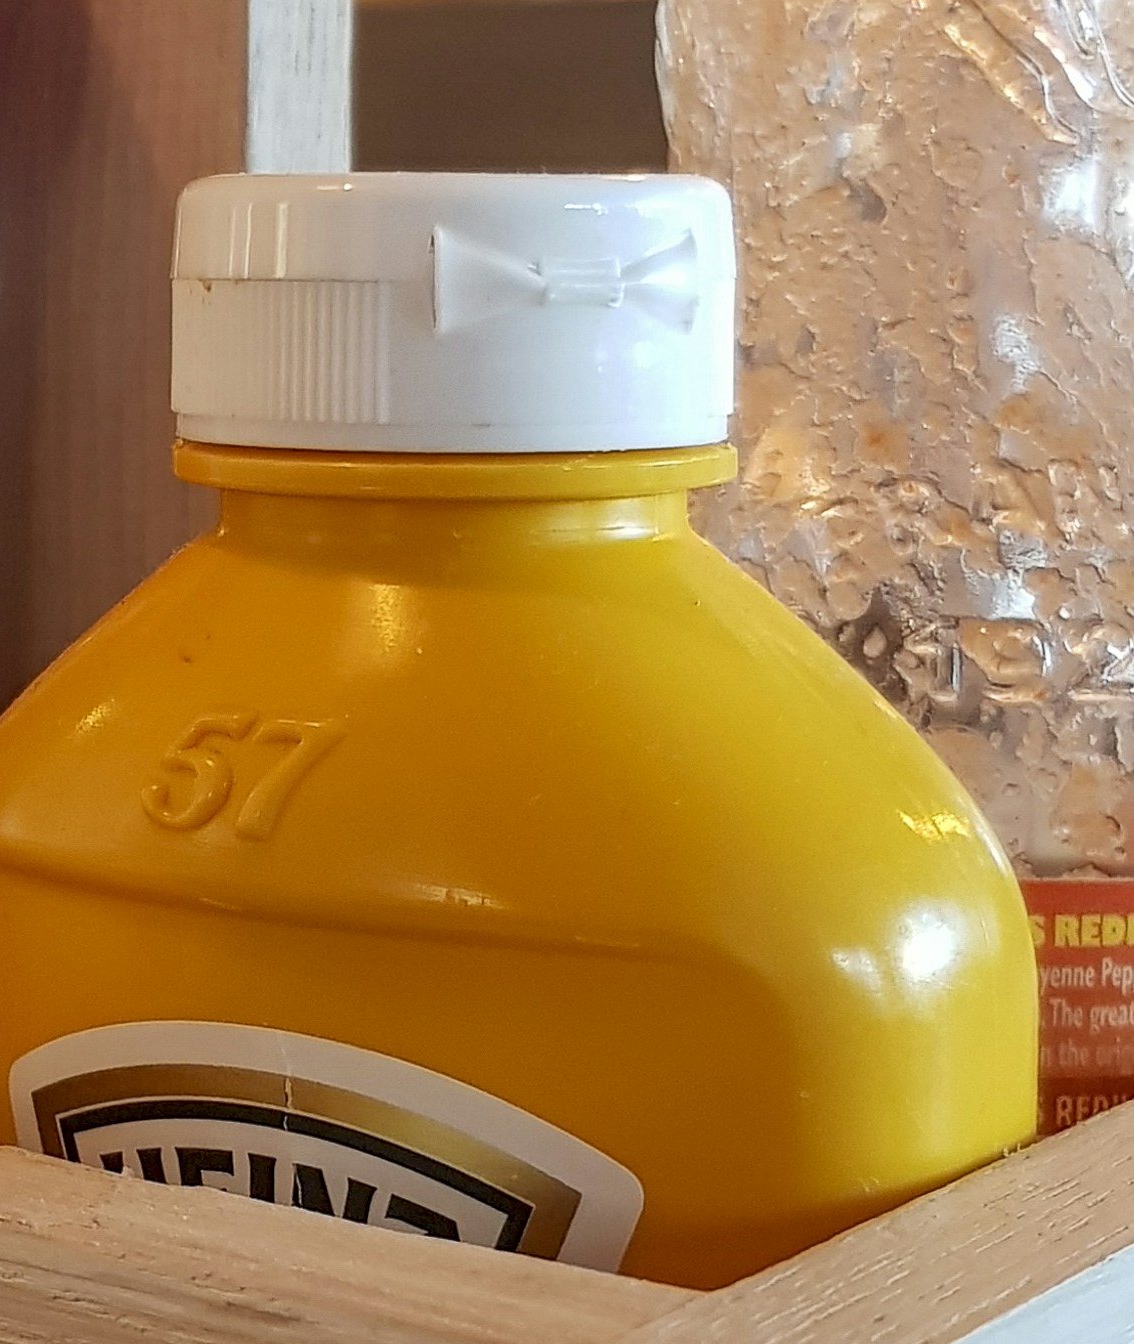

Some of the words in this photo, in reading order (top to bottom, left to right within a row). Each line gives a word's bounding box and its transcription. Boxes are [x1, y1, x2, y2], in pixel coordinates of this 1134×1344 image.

[141, 709, 348, 843] 57
[1101, 956, 1134, 997] Pep
[1049, 997, 1083, 1028] The
